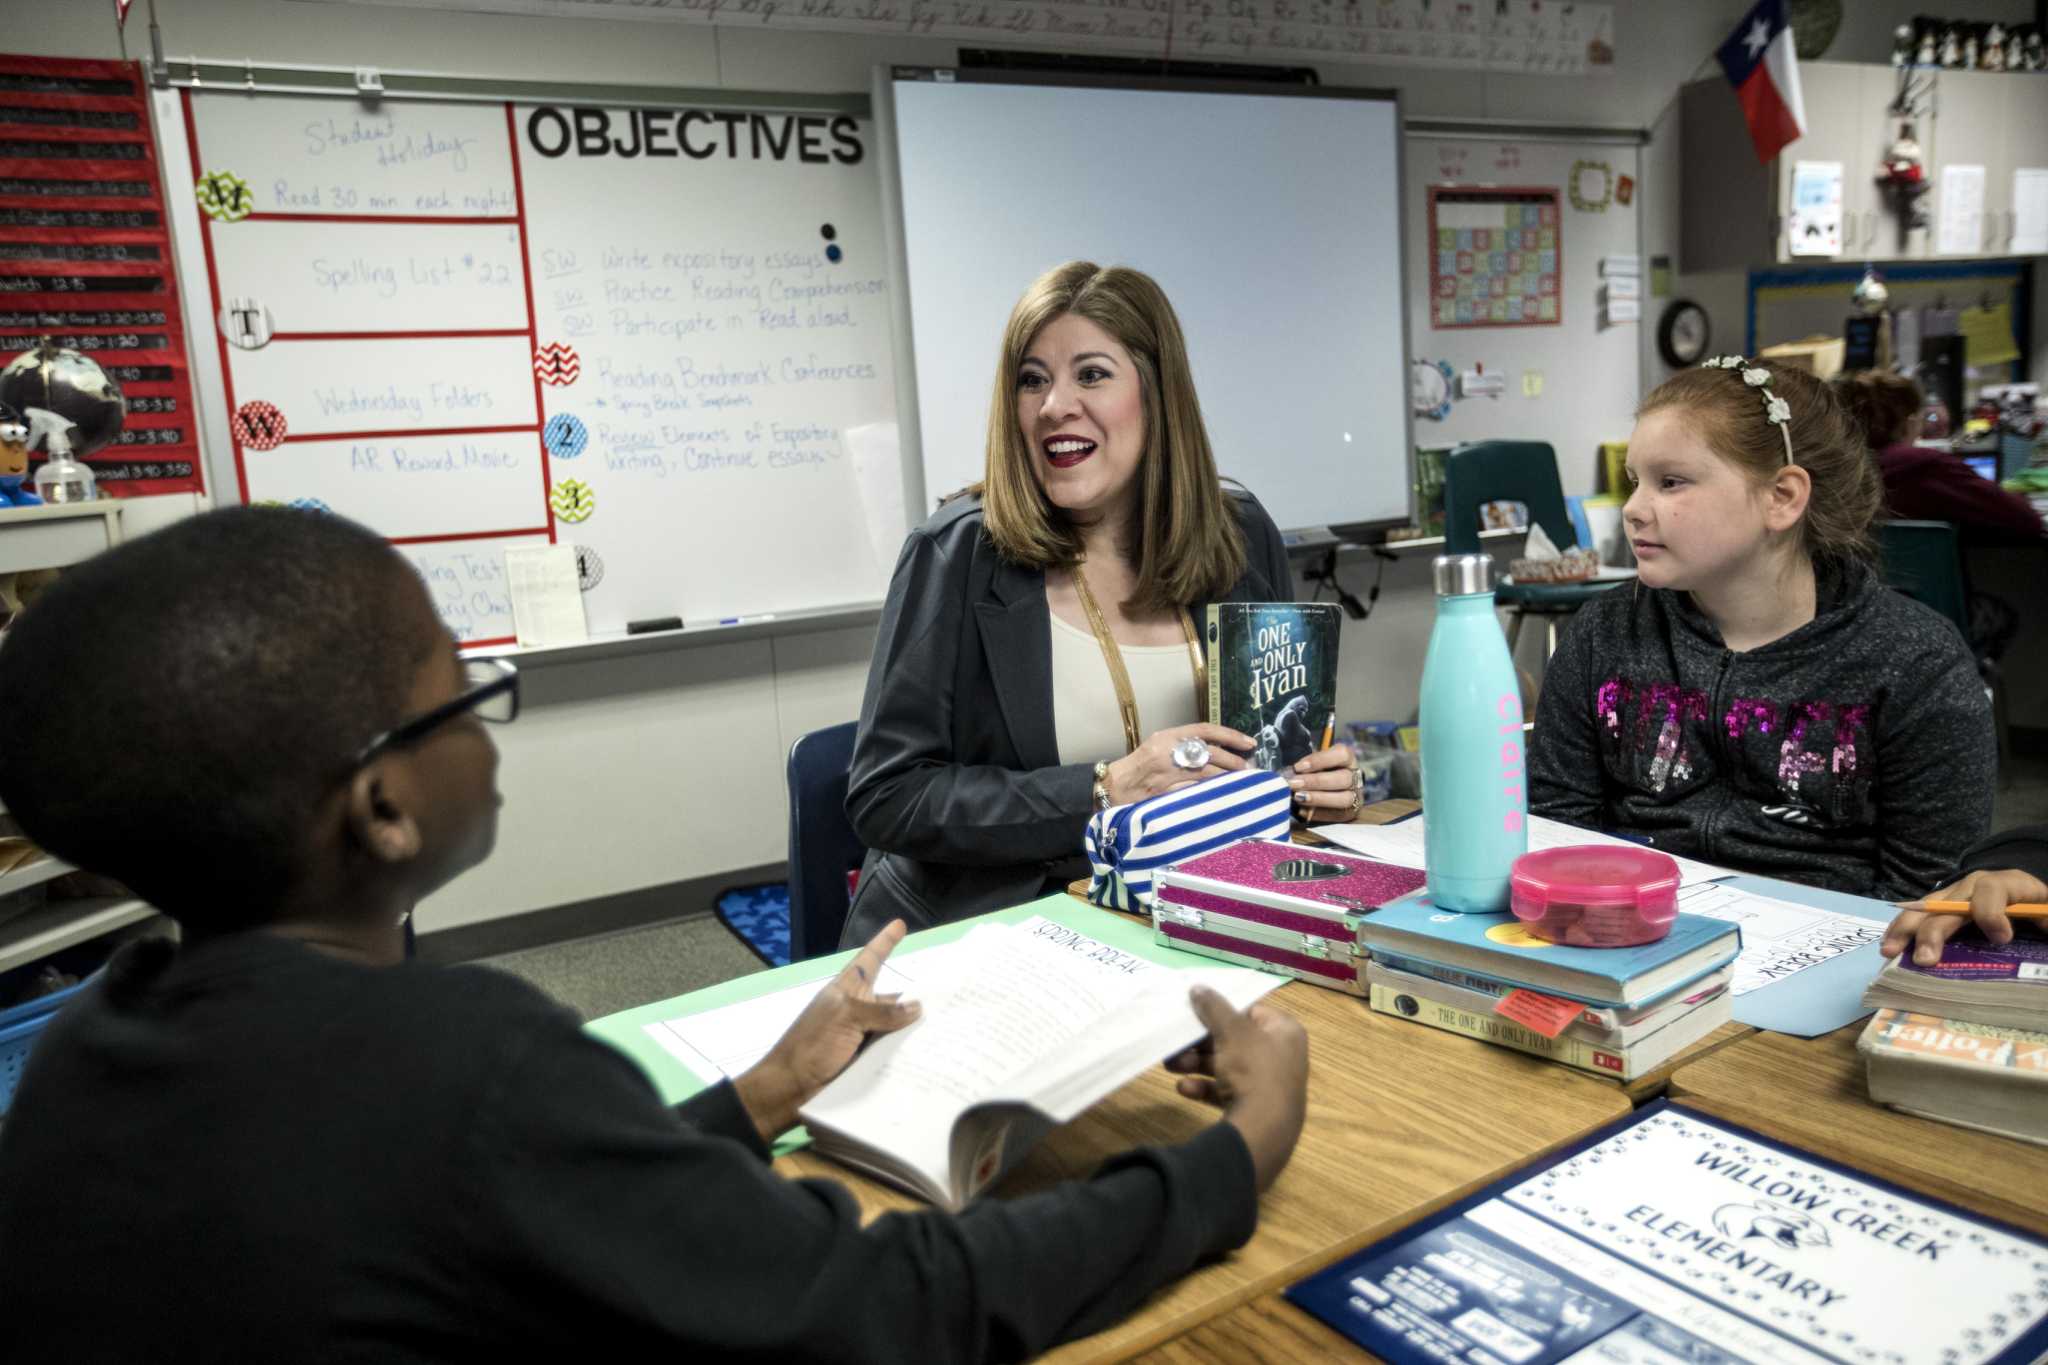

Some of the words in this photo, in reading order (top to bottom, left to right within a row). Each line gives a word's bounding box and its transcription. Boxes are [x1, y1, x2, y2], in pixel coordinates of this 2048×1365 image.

[527, 106, 864, 165] OBJECTIVES
[274, 179, 321, 207] Read
[331, 187, 359, 209] 30
[369, 193, 398, 209] min
[416, 187, 450, 209] each
[312, 258, 398, 297] Spelling
[409, 259, 455, 286] List
[604, 278, 673, 304] Practice
[692, 277, 761, 311] Reading
[232, 308, 260, 337] T
[612, 310, 714, 342] Participate
[552, 351, 562, 375] 1
[599, 356, 674, 391] Reading
[314, 386, 424, 421] Wednesday
[239, 410, 280, 440] W
[557, 422, 574, 447] 2
[565, 487, 580, 510] 3
[1258, 621, 1292, 652] ONE
[1263, 641, 1307, 675] ONLY
[1250, 664, 1308, 710] Ivan
[1497, 692, 1523, 834] Claire
[1437, 1007, 1456, 1024] THE
[1457, 1012, 1476, 1029] ONE
[1479, 1018, 1499, 1037] AND
[1501, 1023, 1527, 1044] ONLY
[1694, 1150, 1831, 1211] WILLOW
[1831, 1206, 1951, 1261] CREEK
[1624, 1203, 1849, 1308] ELEMENTARY
